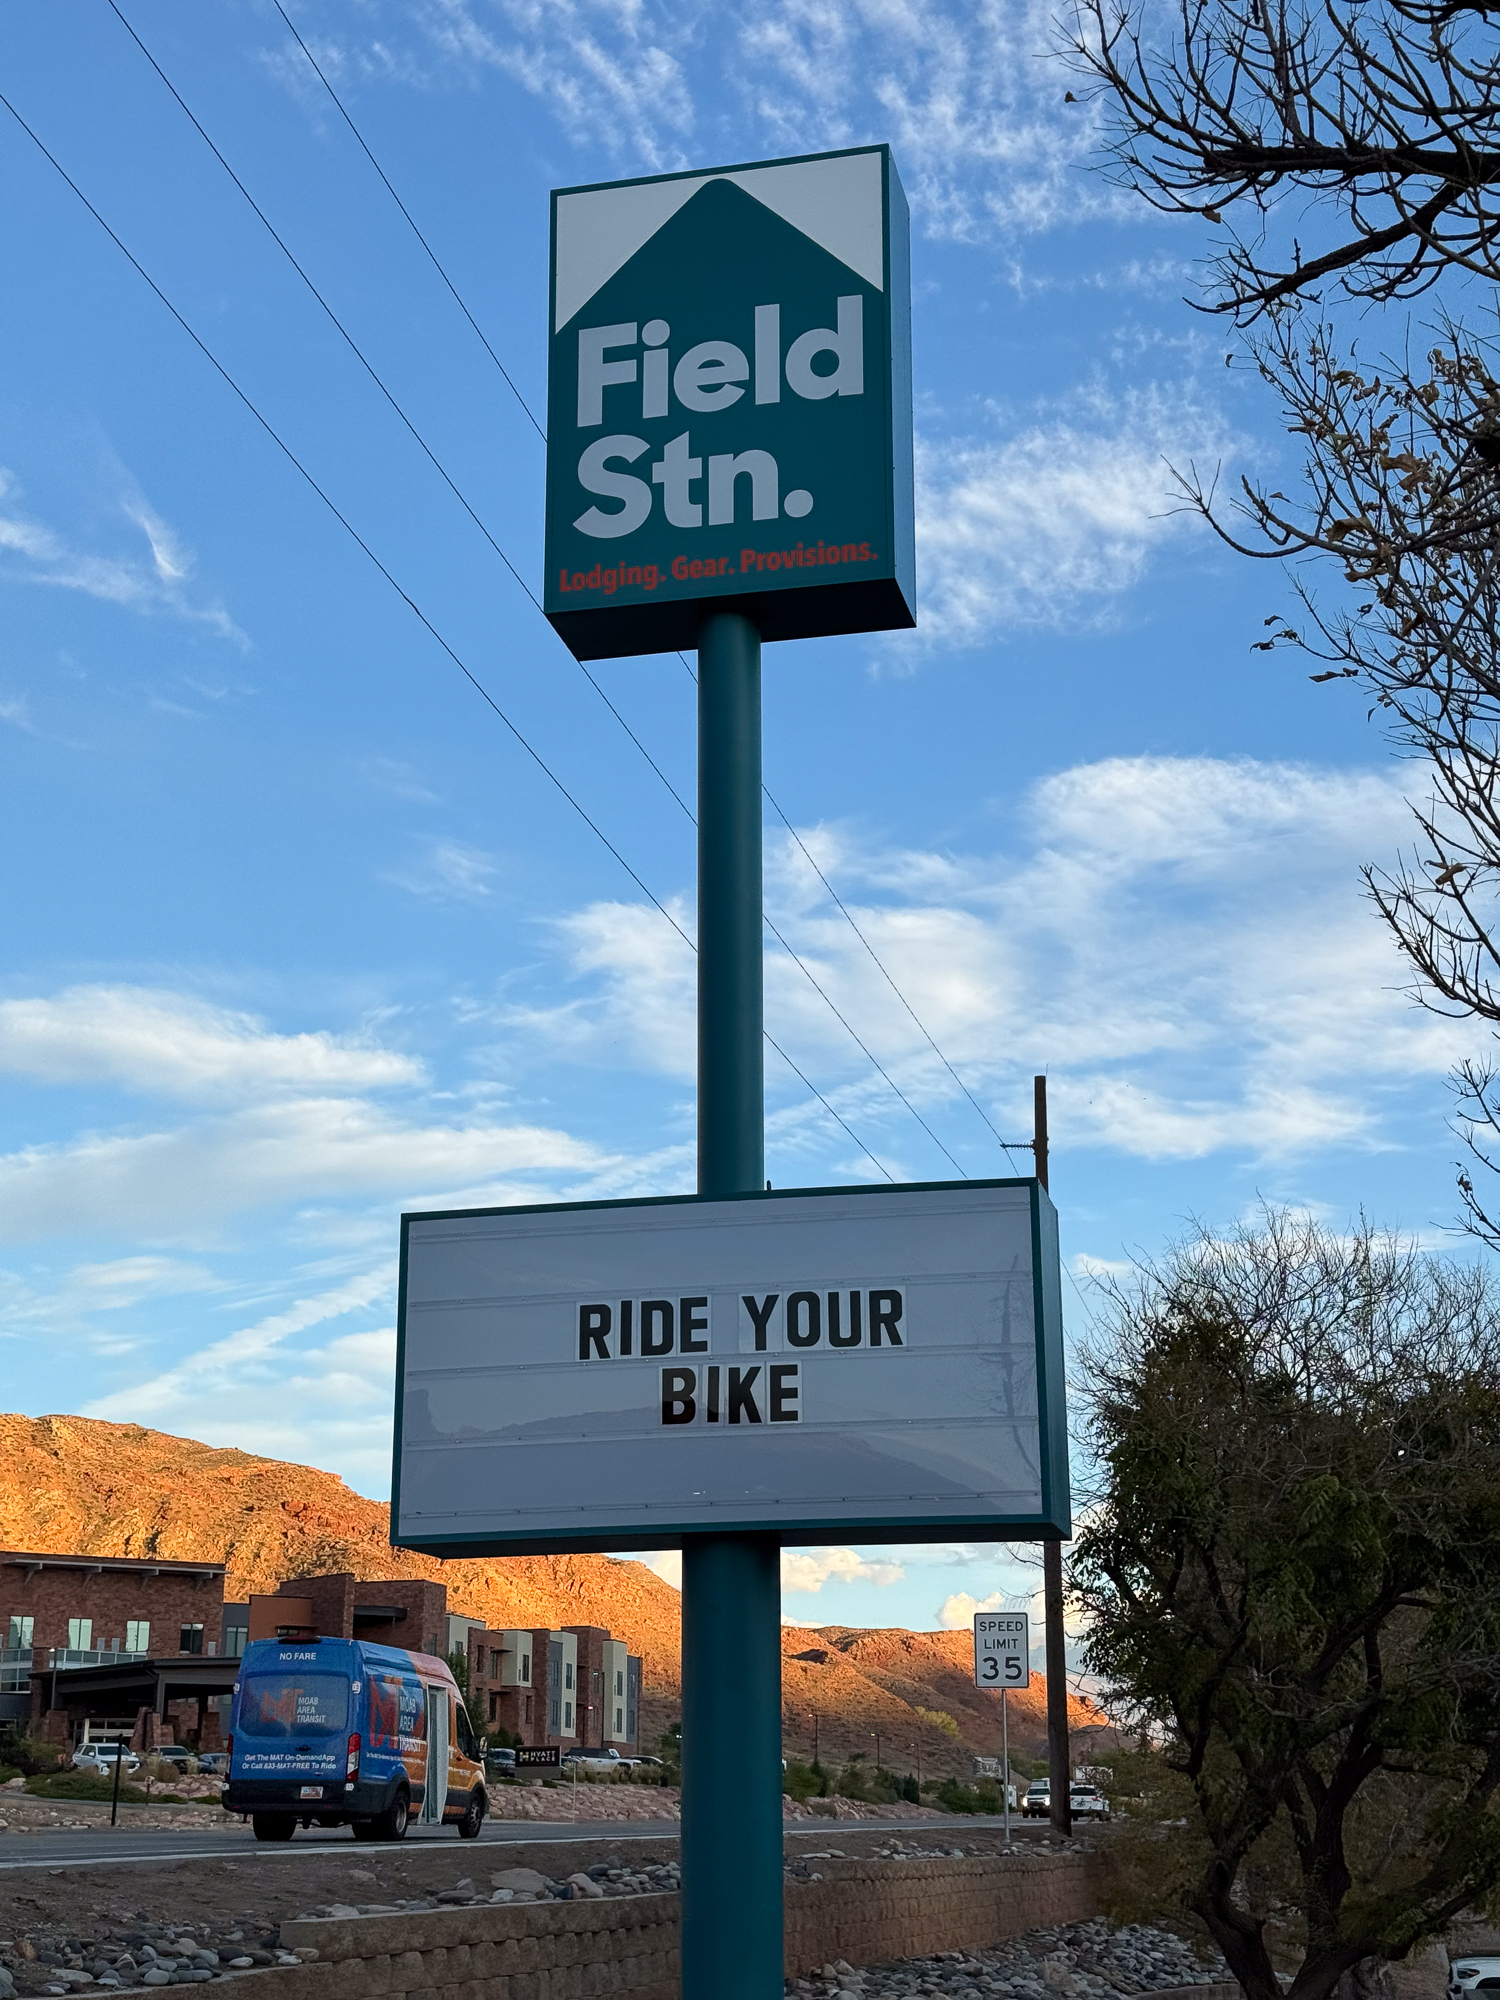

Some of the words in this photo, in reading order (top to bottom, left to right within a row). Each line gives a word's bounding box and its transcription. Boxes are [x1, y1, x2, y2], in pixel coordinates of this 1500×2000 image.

[577, 294, 864, 428] Field
[572, 430, 814, 538] Stn.
[559, 560, 667, 595] Lodging.
[671, 555, 735, 581] Gear.
[740, 540, 879, 574] Provisions.
[579, 1296, 708, 1361] RIDE
[741, 1289, 904, 1351] YOUR
[661, 1364, 799, 1425] BIKE
[979, 1621, 1024, 1632] SPEED
[984, 1638, 1019, 1650] LIMIT
[279, 1652, 293, 1660] NO
[294, 1652, 317, 1660] FARE
[981, 1656, 1023, 1680] 35
[296, 1706, 316, 1714] AREA
[298, 1696, 319, 1706] MOAB
[399, 1695, 417, 1714] MOAB
[296, 1714, 327, 1724] TRANSIT
[398, 1714, 414, 1733] AREA
